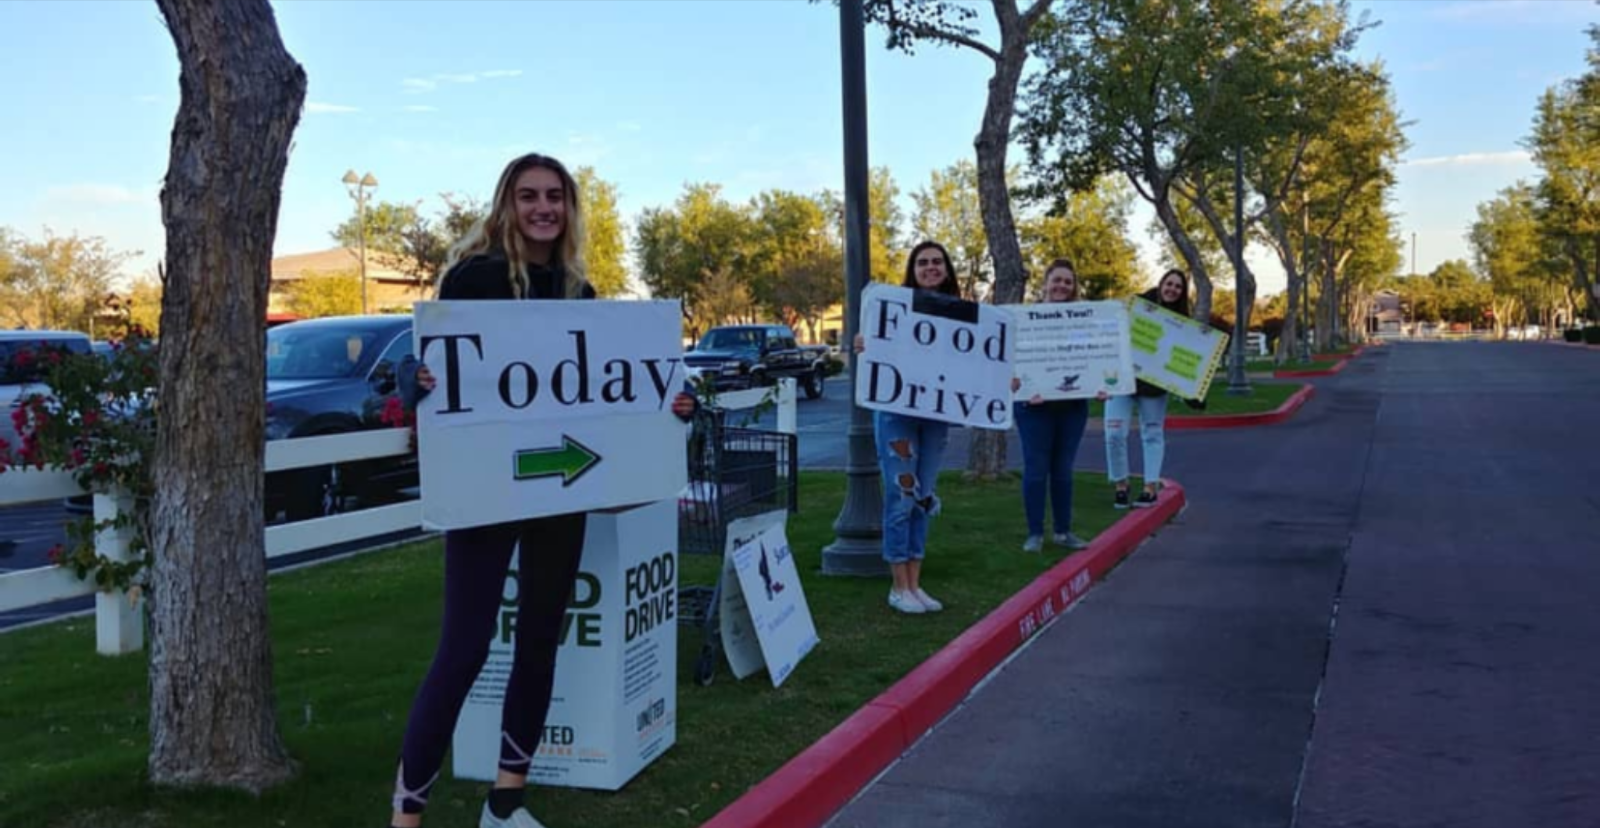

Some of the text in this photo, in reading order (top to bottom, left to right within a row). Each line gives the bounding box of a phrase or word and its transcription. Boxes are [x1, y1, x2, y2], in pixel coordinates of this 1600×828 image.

[871, 297, 1008, 363] Food
[1028, 308, 1062, 320] Thank
[420, 330, 681, 415] Today
[865, 359, 1007, 424] Drive
[625, 552, 675, 607] FOOD
[624, 587, 675, 643] DRIVE
[541, 725, 575, 746] TED
